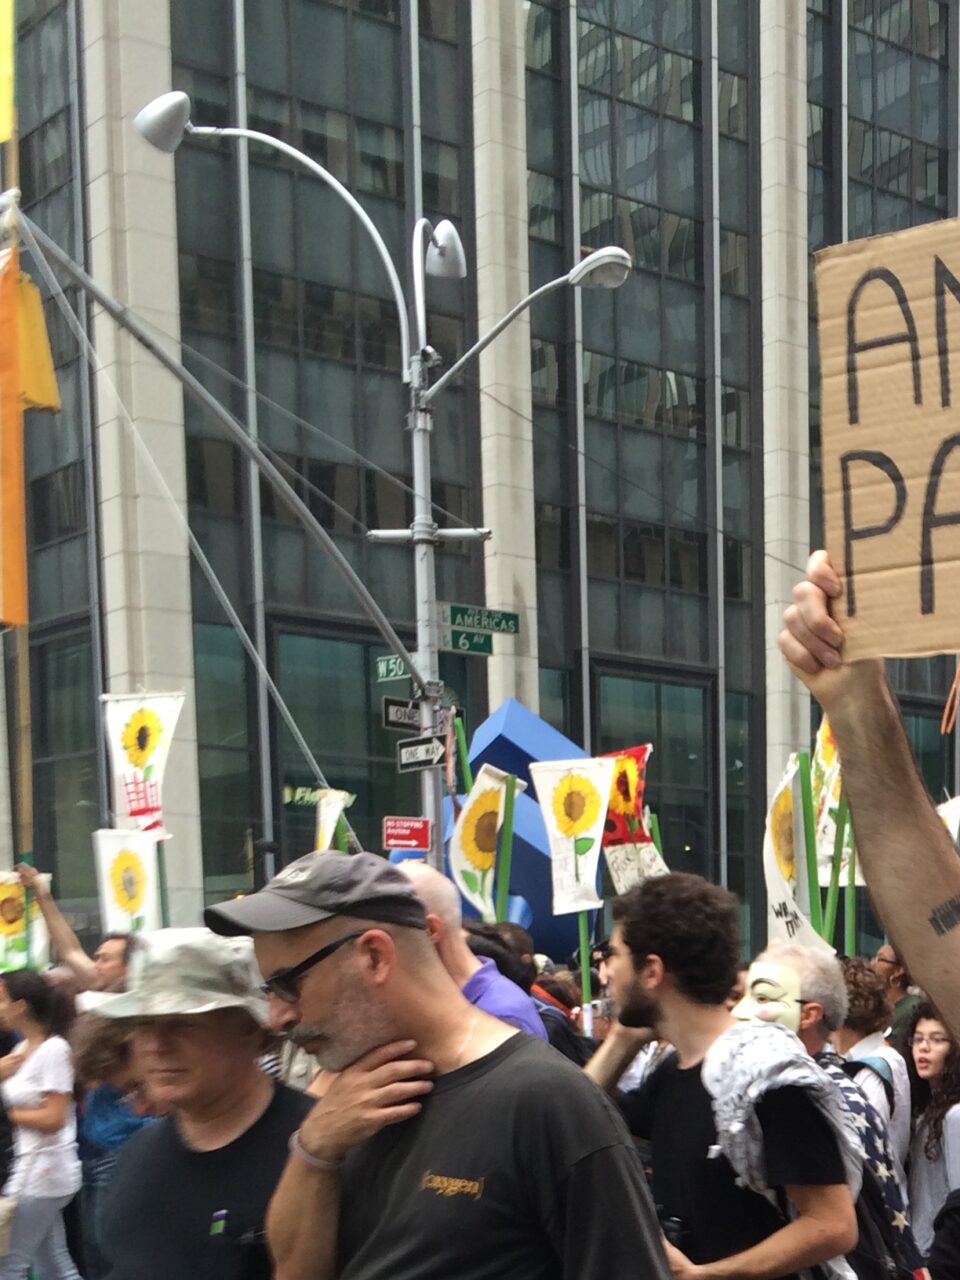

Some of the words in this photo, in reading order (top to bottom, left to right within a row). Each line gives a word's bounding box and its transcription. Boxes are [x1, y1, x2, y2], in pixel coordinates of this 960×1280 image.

[455, 613, 516, 633] AMERICAS
[459, 633, 470, 650] 6
[378, 660, 387, 678] W
[388, 658, 404, 676] 50
[405, 749, 419, 762] ONE
